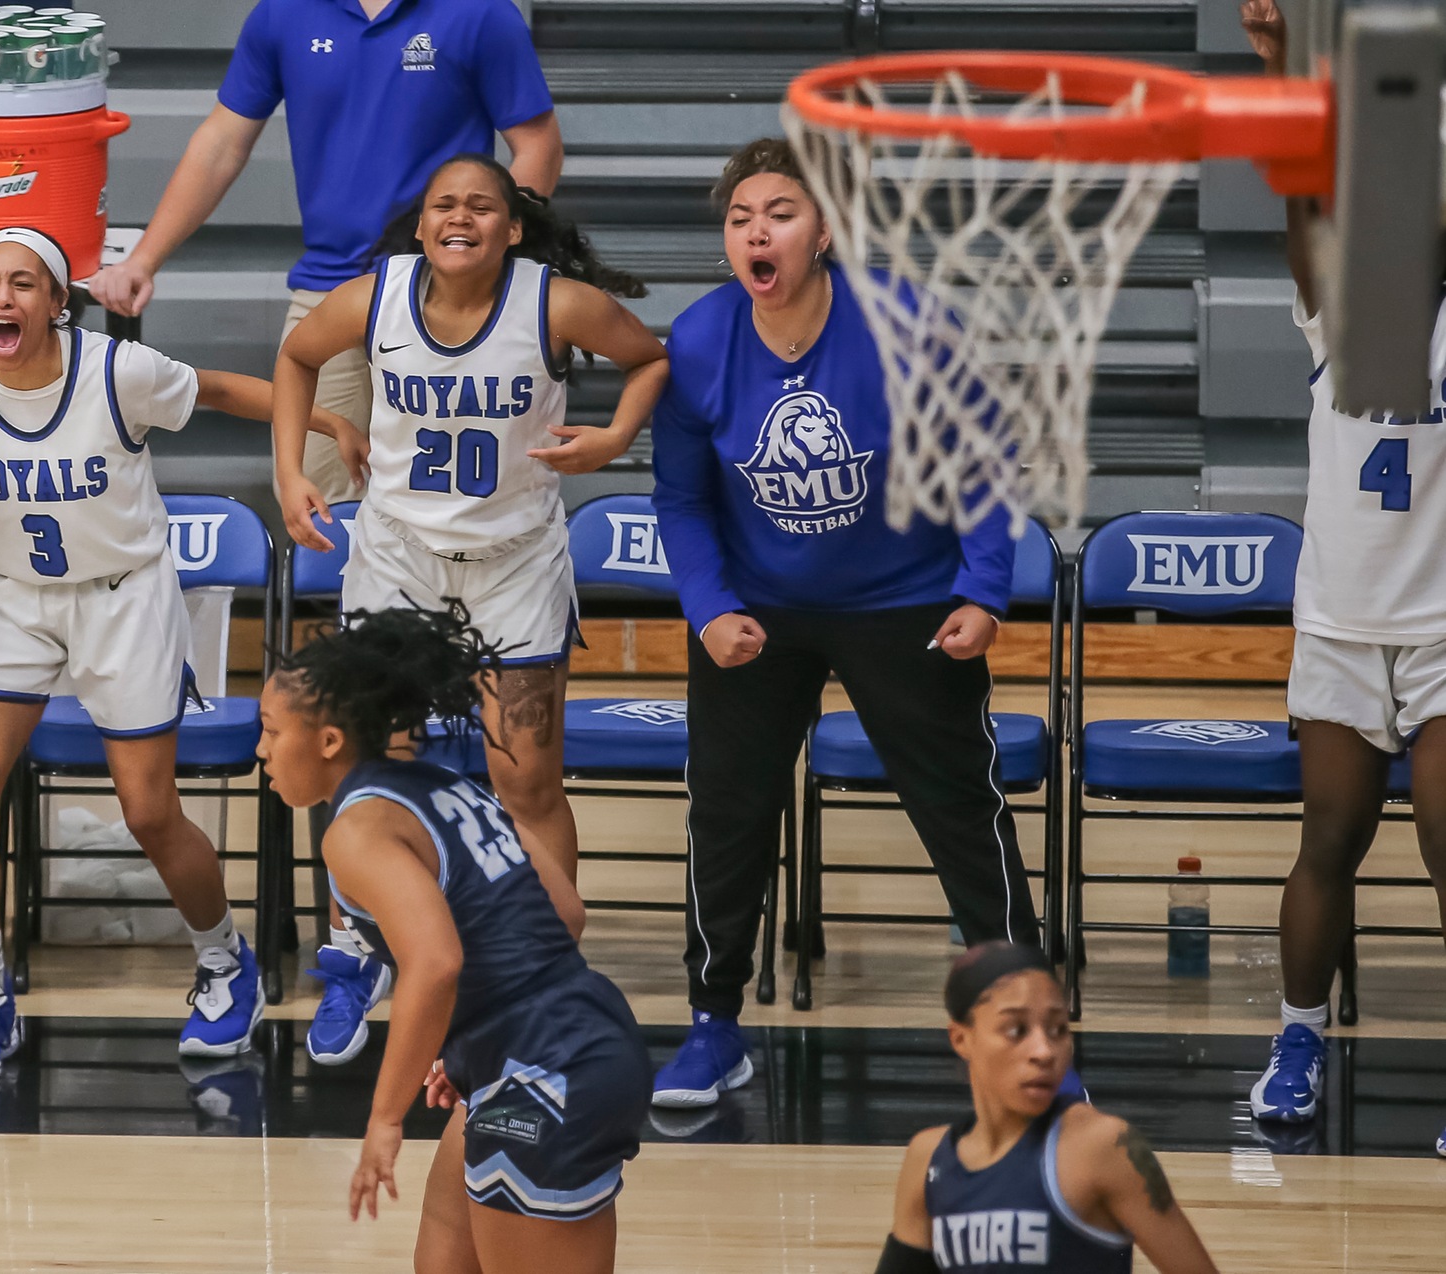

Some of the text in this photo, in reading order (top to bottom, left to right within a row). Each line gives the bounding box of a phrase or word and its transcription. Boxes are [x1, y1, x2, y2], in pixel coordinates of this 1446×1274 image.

[382, 368, 534, 418] ROYALS
[409, 427, 499, 498] 20
[752, 462, 859, 507] EMU
[1359, 438, 1412, 511] 4
[21, 513, 69, 577] 3
[766, 506, 864, 534] SKETBAL
[1141, 542, 1259, 587] EMU
[429, 781, 526, 882] 23
[932, 1210, 1049, 1269] ATORS
